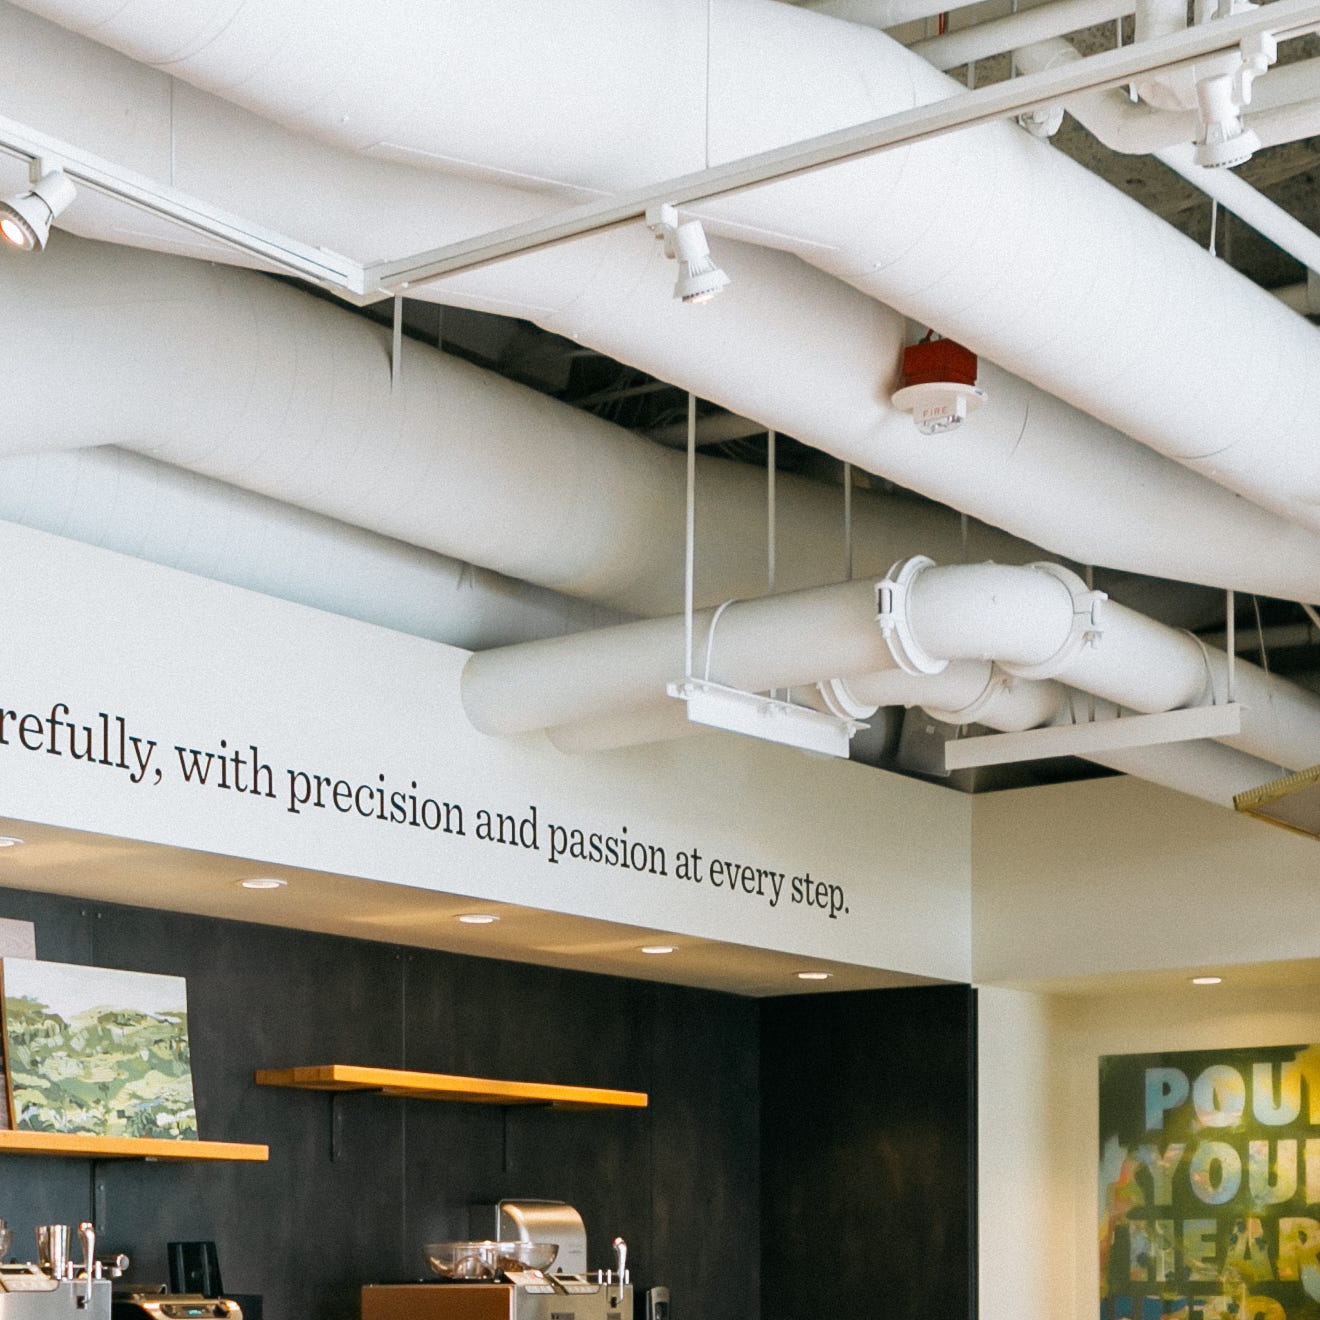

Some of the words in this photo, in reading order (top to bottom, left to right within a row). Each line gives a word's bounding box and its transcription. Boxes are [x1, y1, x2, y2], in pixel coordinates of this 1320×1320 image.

[923, 406, 947, 418] FIRE
[173, 739, 277, 799] with
[286, 769, 467, 837] precision
[475, 805, 540, 851] and
[547, 823, 668, 877] passion
[675, 847, 703, 884] at
[709, 858, 786, 908] every
[791, 873, 850, 920] step.
